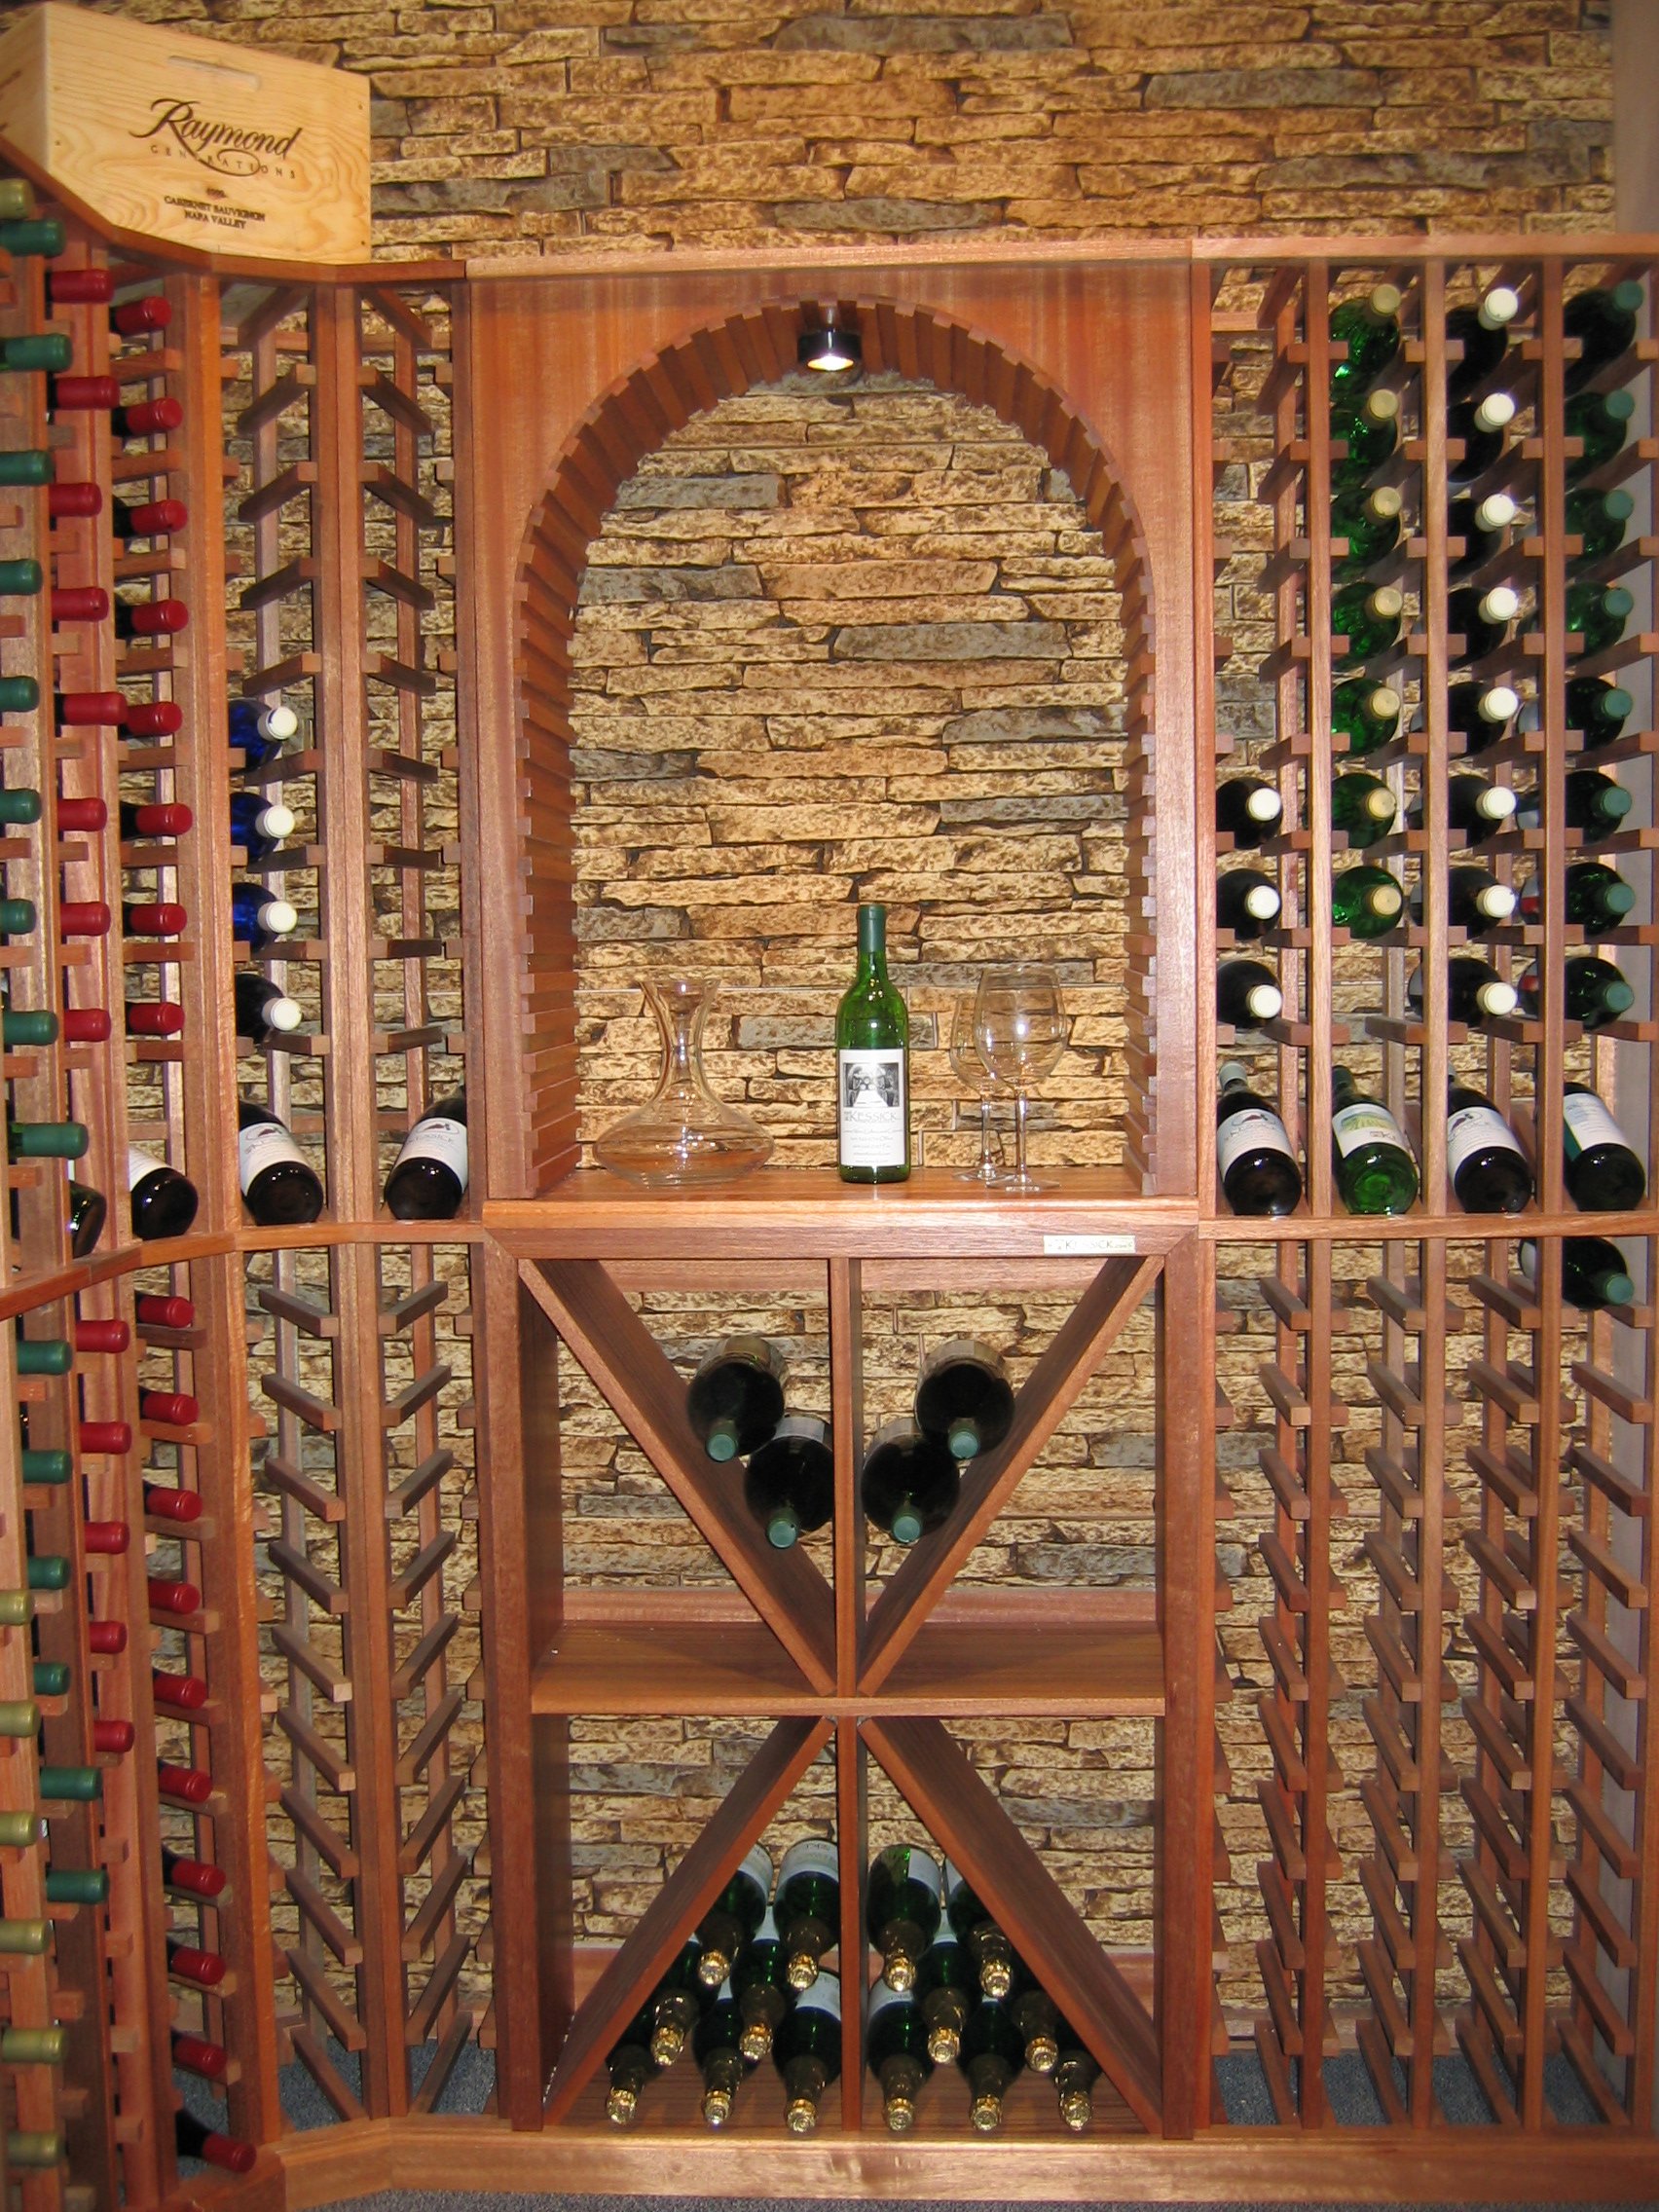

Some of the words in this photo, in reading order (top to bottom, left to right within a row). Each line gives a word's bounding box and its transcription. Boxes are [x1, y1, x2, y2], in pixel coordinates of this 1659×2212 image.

[128, 97, 303, 177] Raymond
[164, 195, 211, 212] CABERNET
[213, 204, 266, 222] SAUVIGNON
[184, 209, 208, 223] NAPA
[211, 214, 246, 229] VALLEY
